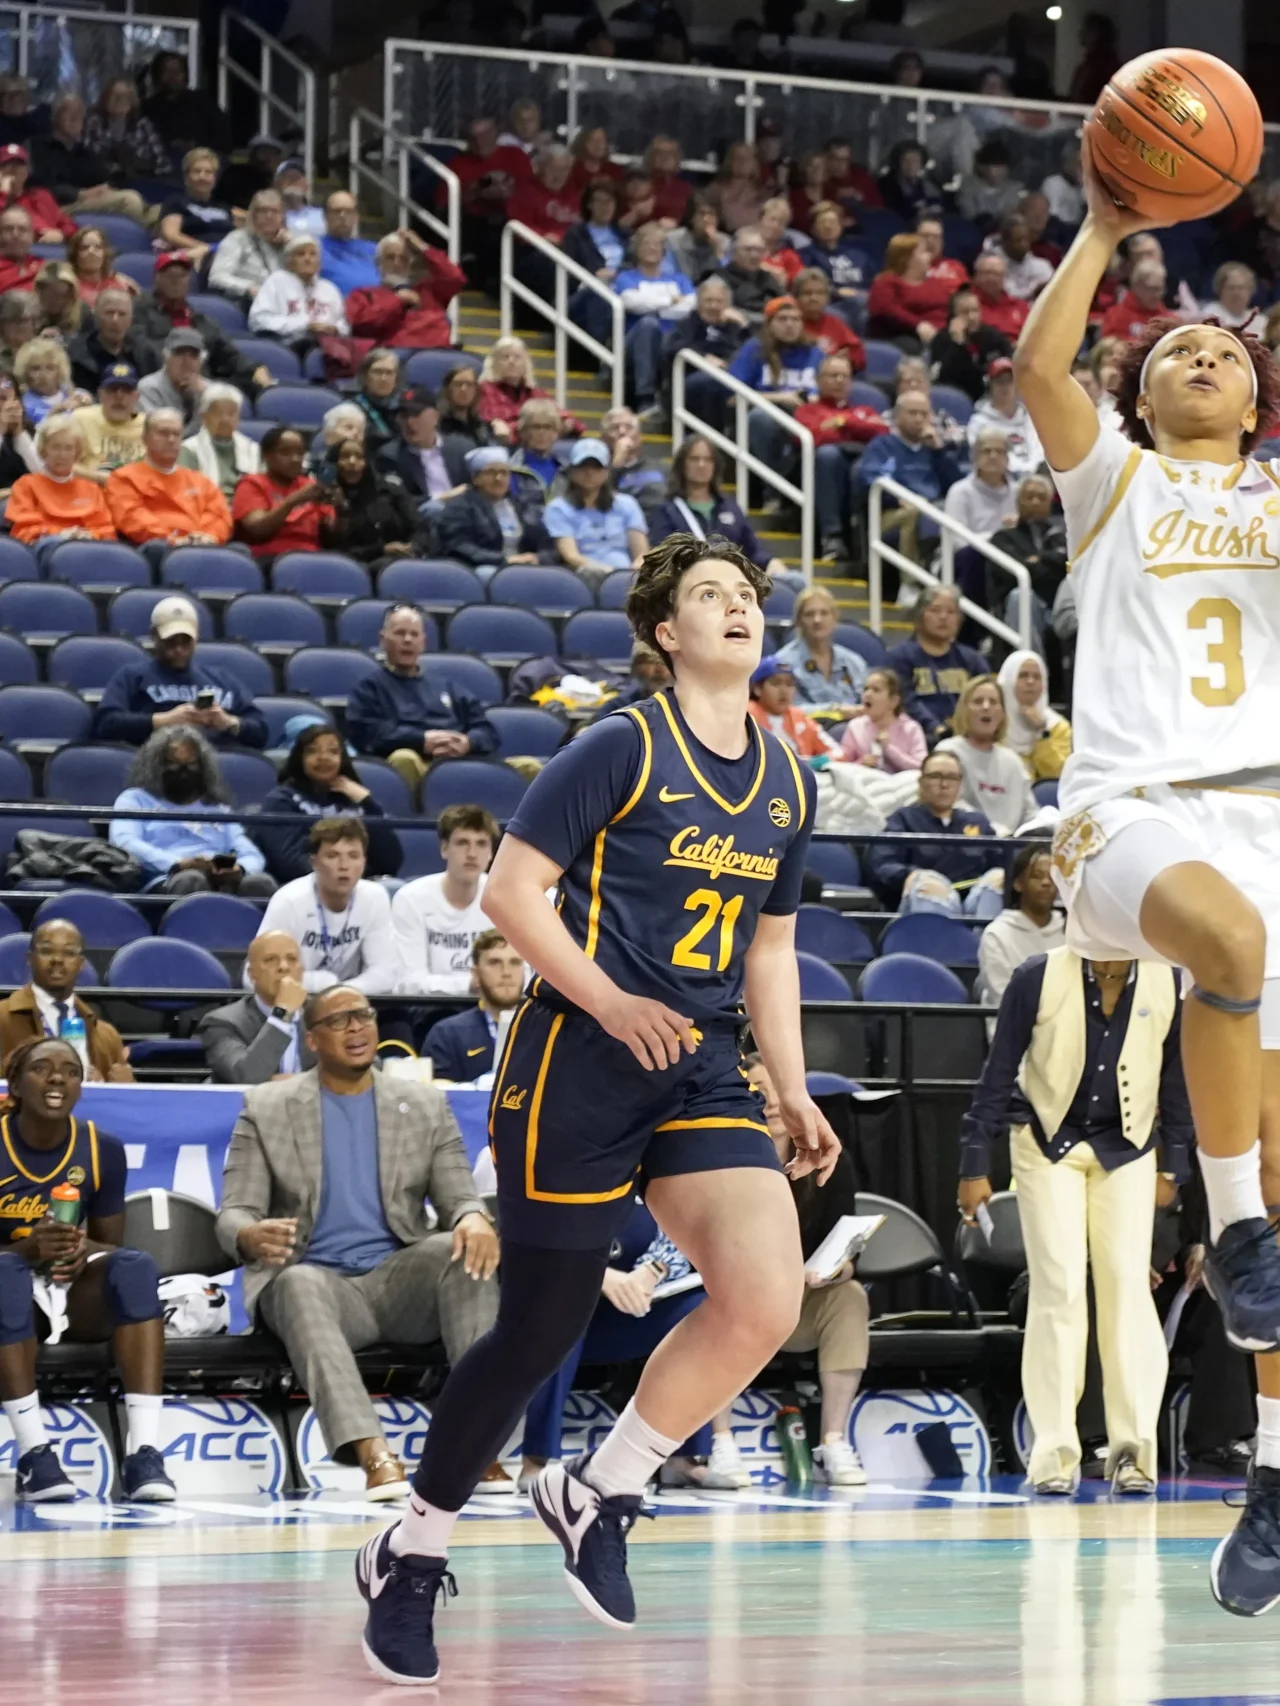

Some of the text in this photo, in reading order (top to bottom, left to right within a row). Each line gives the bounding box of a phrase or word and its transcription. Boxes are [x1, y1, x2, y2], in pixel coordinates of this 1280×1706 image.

[1133, 74, 1204, 139] LEGAC
[1099, 95, 1178, 179] SPALD
[1143, 507, 1280, 574] Irish
[1187, 597, 1246, 707] 3
[664, 826, 779, 881] California
[671, 888, 744, 972] 21
[500, 1085, 528, 1110] Cal
[0, 1193, 49, 1222] Califo
[0, 1437, 98, 1469] AC
[161, 1432, 272, 1462] ACC
